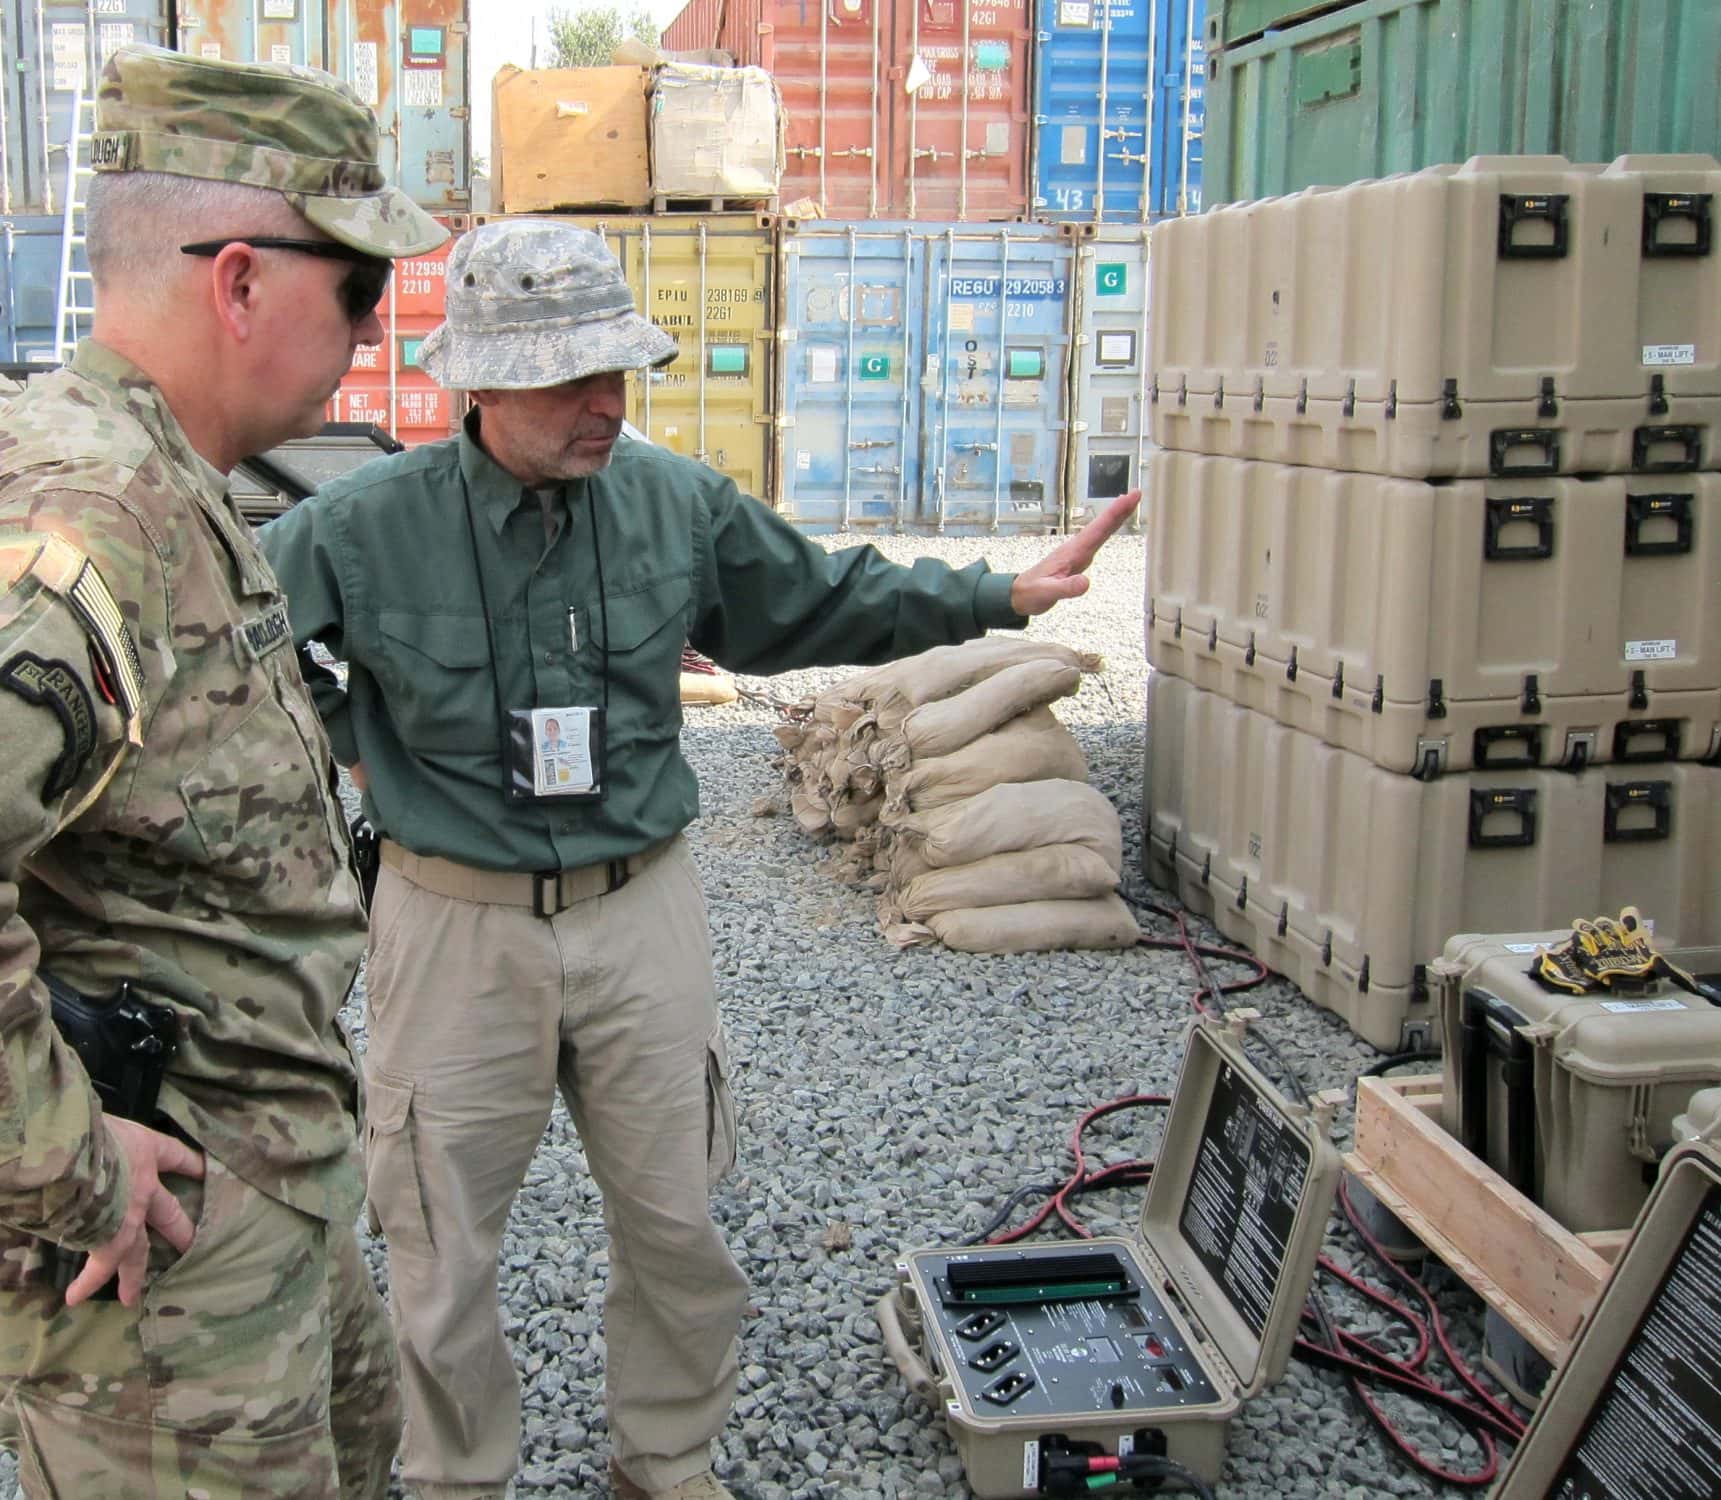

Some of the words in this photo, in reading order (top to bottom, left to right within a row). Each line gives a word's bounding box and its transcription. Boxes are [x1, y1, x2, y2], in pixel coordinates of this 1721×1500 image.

[1056, 189, 1083, 211] 43
[1104, 272, 1118, 287] G
[402, 281, 431, 294] 2210
[953, 280, 993, 295] REGU
[1006, 280, 1054, 295] 292058
[658, 289, 688, 302] EPIU
[707, 289, 748, 302] 238169
[1007, 303, 1034, 317] 2210
[652, 315, 694, 326] KABUL
[867, 358, 881, 372] G
[349, 394, 368, 408] NET
